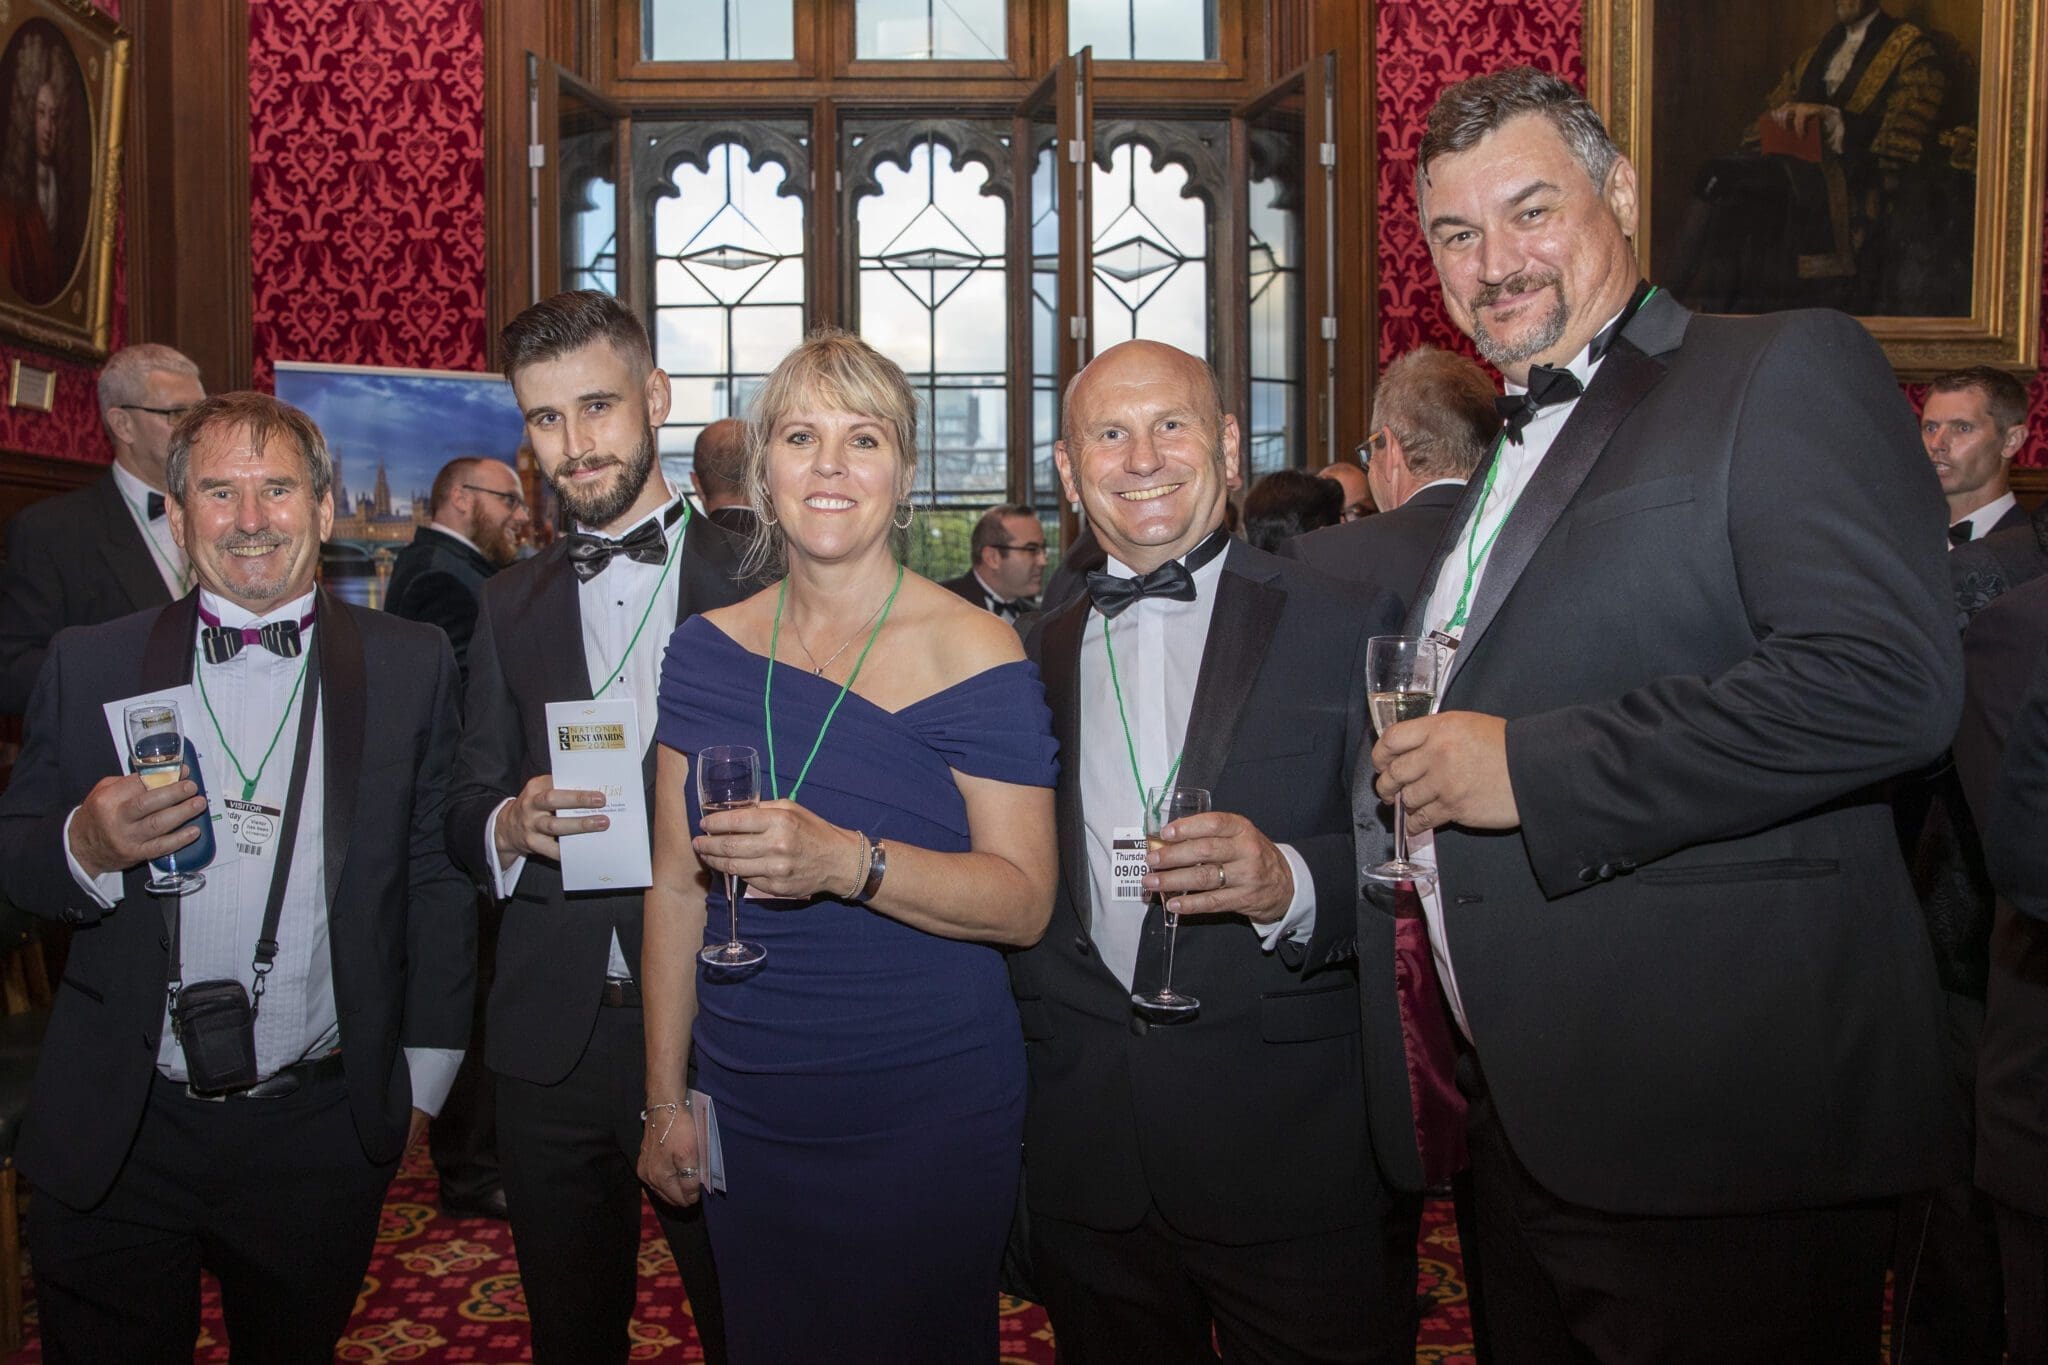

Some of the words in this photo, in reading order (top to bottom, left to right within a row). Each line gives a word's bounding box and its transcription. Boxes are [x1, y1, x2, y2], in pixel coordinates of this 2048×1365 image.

[570, 725, 624, 733] NATIONAL
[572, 734, 591, 742] PEST
[592, 733, 624, 741] AWARDS
[588, 742, 610, 750] 2021
[230, 801, 262, 812] VISITOR
[228, 812, 241, 821] day
[1134, 841, 1148, 849] VIS
[1116, 852, 1147, 863] Thursday
[1114, 865, 1148, 877] 09/09
